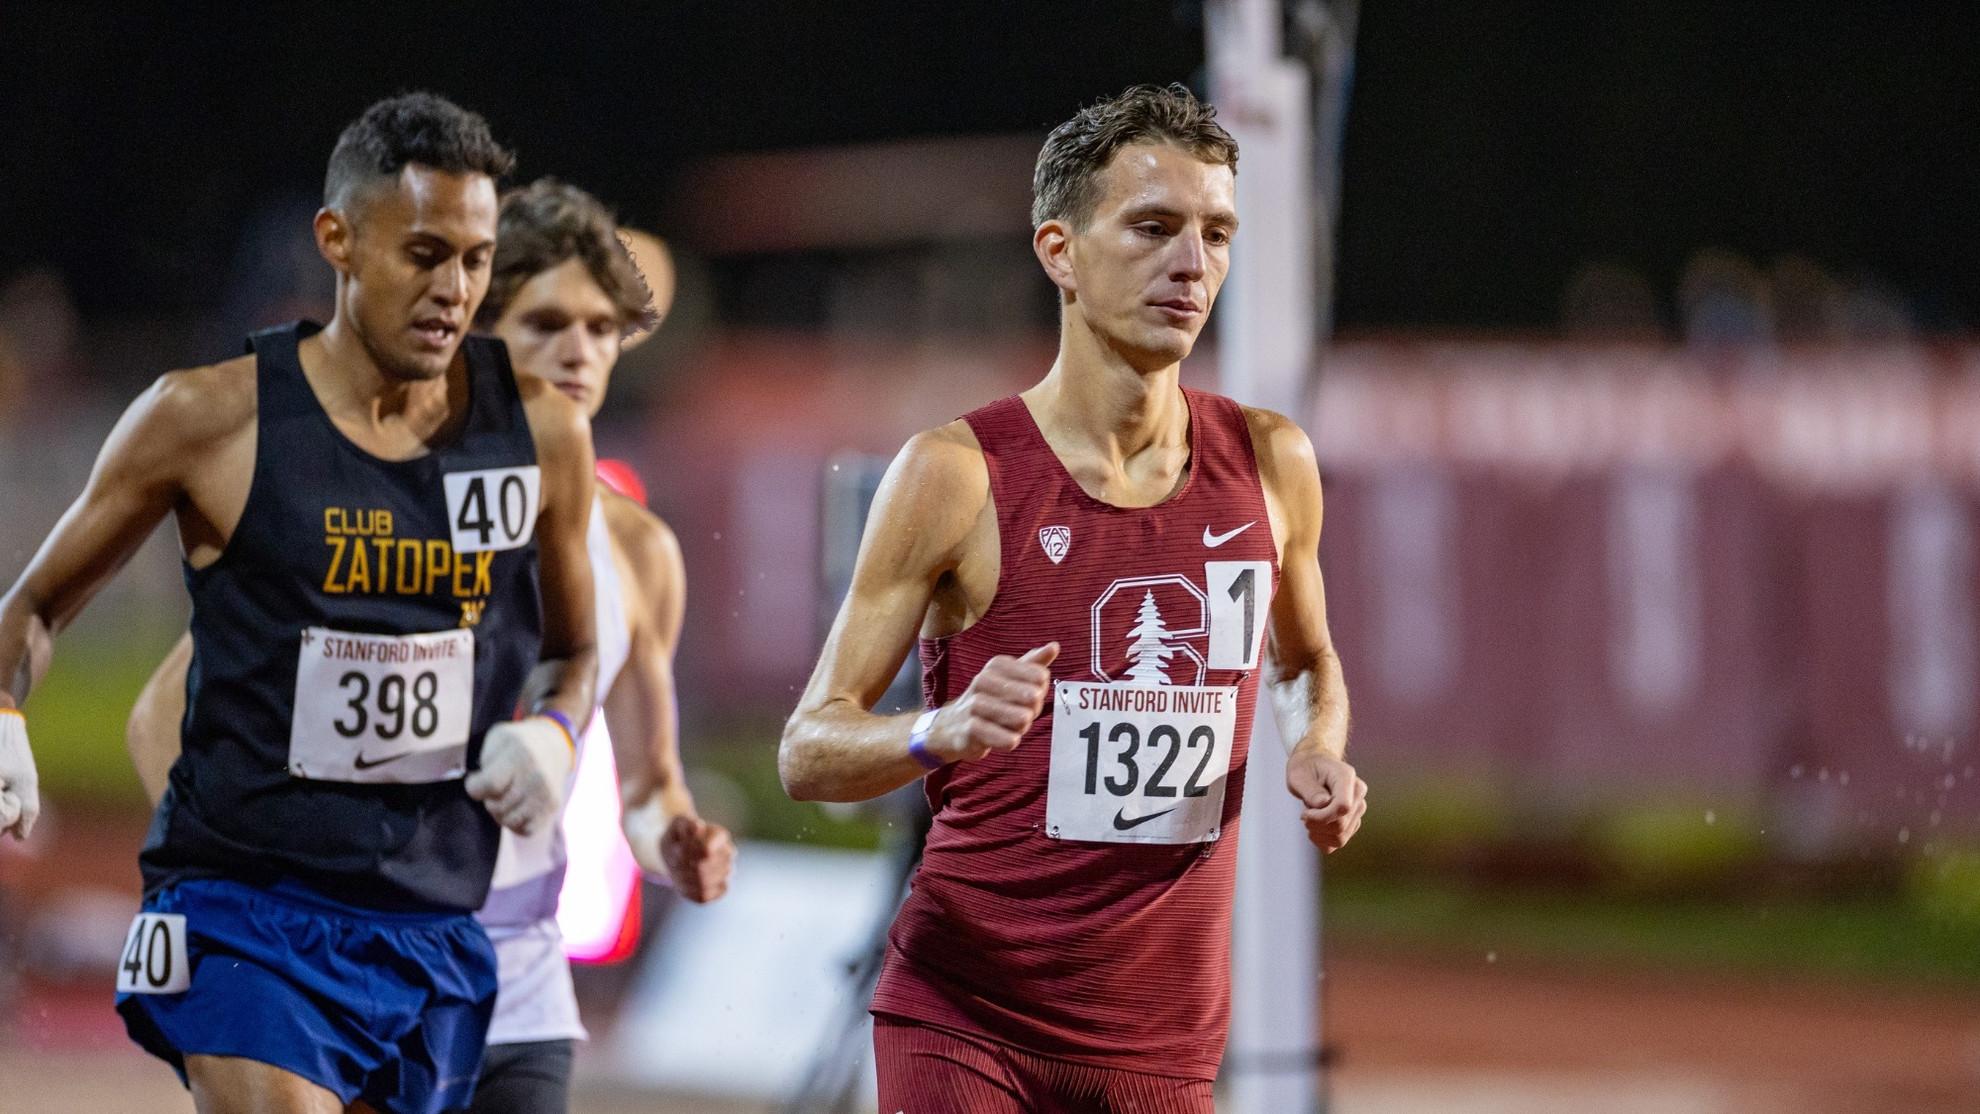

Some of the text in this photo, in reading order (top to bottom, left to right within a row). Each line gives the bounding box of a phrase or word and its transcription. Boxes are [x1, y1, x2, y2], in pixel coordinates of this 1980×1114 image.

[324, 507, 393, 535] CLUB
[457, 475, 527, 544] 40
[1041, 527, 1068, 548] PAC
[323, 537, 495, 597] ZATOPEK
[1050, 543, 1064, 556] 12
[1227, 568, 1256, 665] 1
[323, 637, 457, 663] STANFORD INVITE
[333, 670, 439, 740] 398
[1079, 687, 1223, 714] STANFORD INVITE
[1079, 721, 1215, 798] 1322
[124, 918, 172, 988] 40
